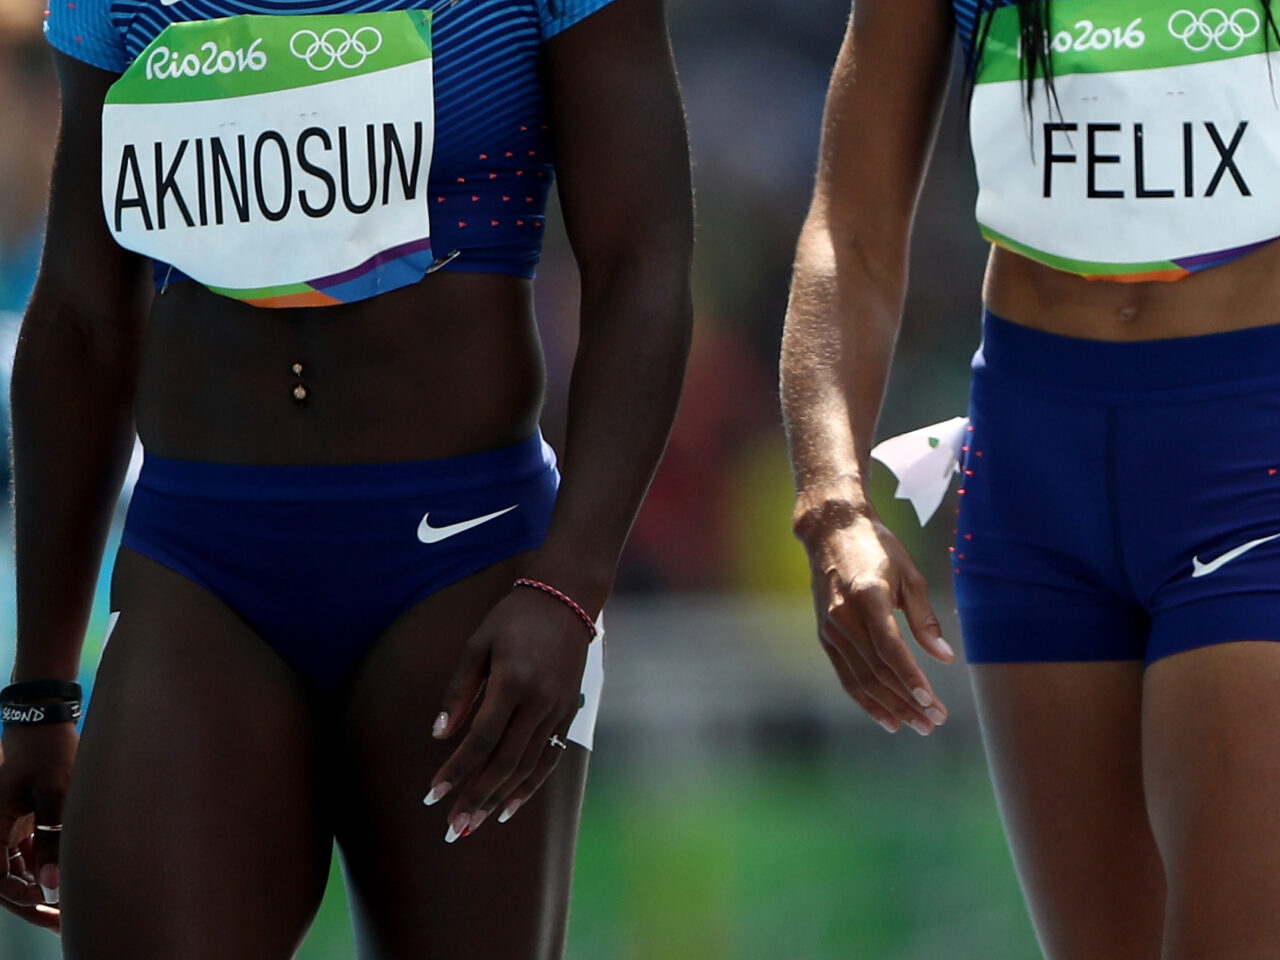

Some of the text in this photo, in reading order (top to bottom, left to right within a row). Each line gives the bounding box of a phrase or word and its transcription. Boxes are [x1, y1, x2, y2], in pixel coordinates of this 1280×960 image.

[145, 38, 268, 80] Rio2016
[1017, 17, 1146, 60] o2016
[114, 121, 423, 232] AKINOSUN
[1042, 121, 1252, 198] FELIX
